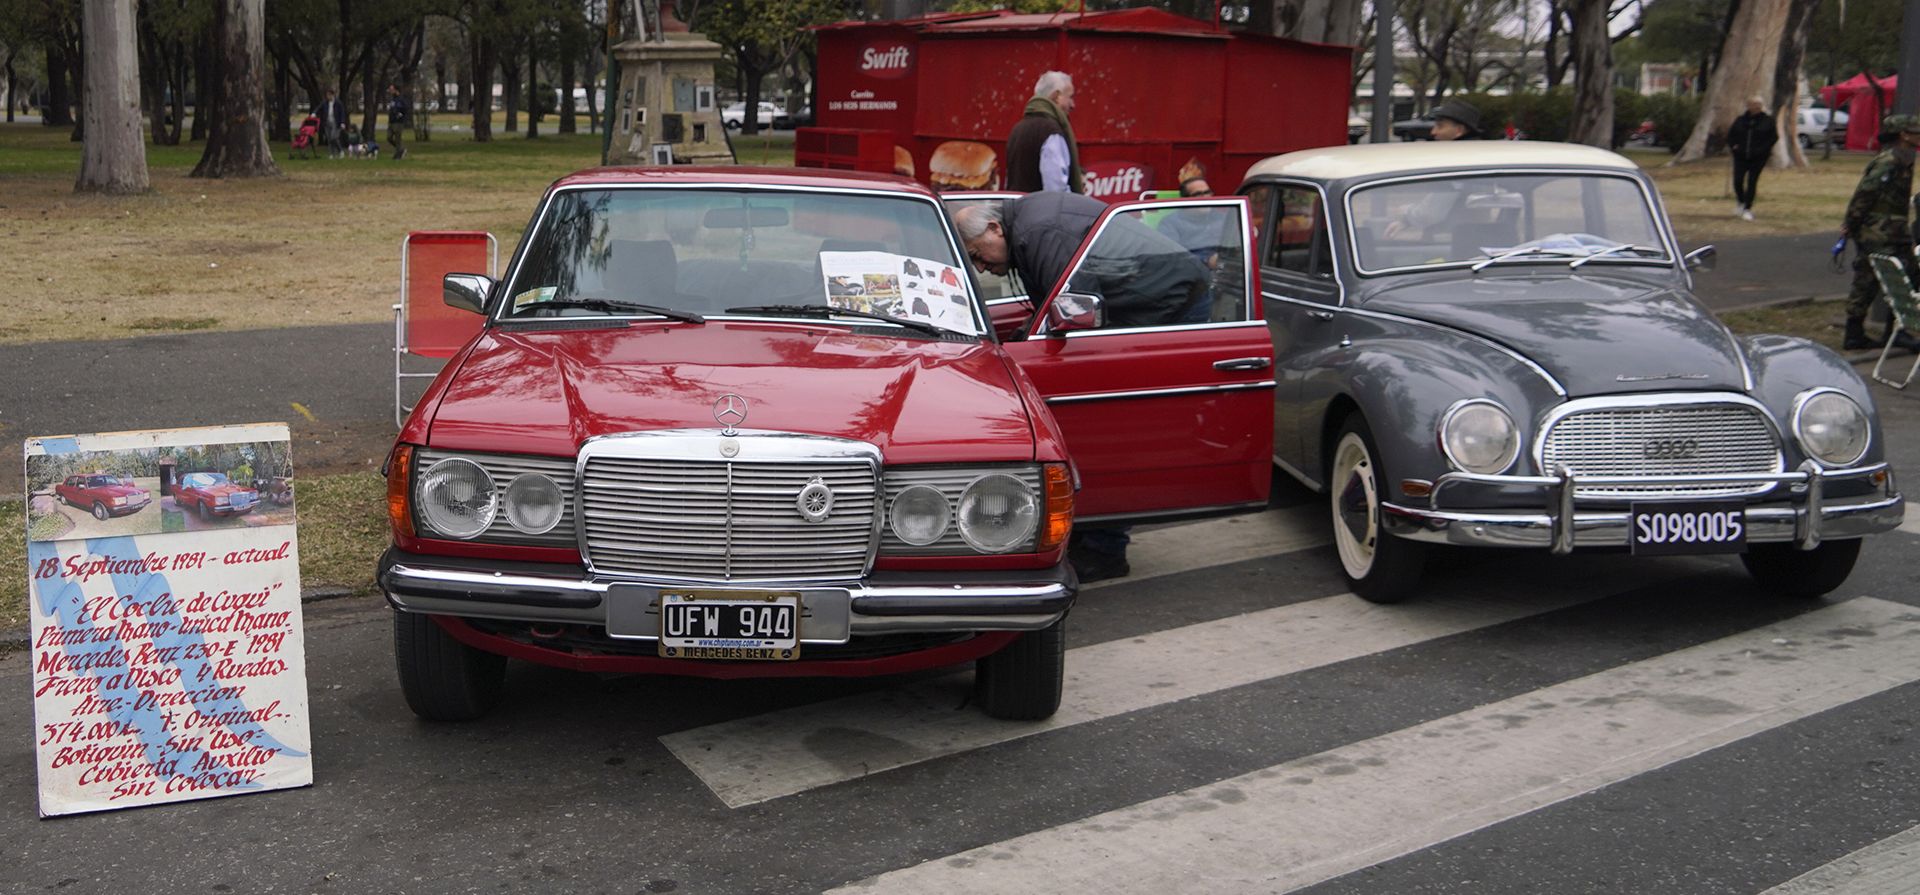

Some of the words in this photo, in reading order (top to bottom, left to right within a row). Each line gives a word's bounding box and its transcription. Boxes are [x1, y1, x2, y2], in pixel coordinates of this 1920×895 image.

[862, 46, 909, 70] Swift
[1082, 167, 1144, 197] Swift
[1636, 511, 1741, 543] S098005
[35, 557, 60, 579] 18
[61, 552, 169, 582] Septiembre
[172, 552, 206, 571] 1981
[109, 592, 184, 620] Coche
[668, 606, 719, 636] UFW
[739, 607, 790, 637] 944
[36, 625, 116, 649] Primera
[37, 645, 131, 676] Mercedes
[131, 642, 182, 667] Benz
[684, 647, 741, 658] MERCEDES
[746, 648, 775, 659] BENZ
[36, 676, 107, 698] Freno
[124, 667, 184, 690] Disco
[51, 739, 149, 769] Botiquin
[79, 758, 178, 786] Cubierta
[192, 745, 282, 773] Auxilio
